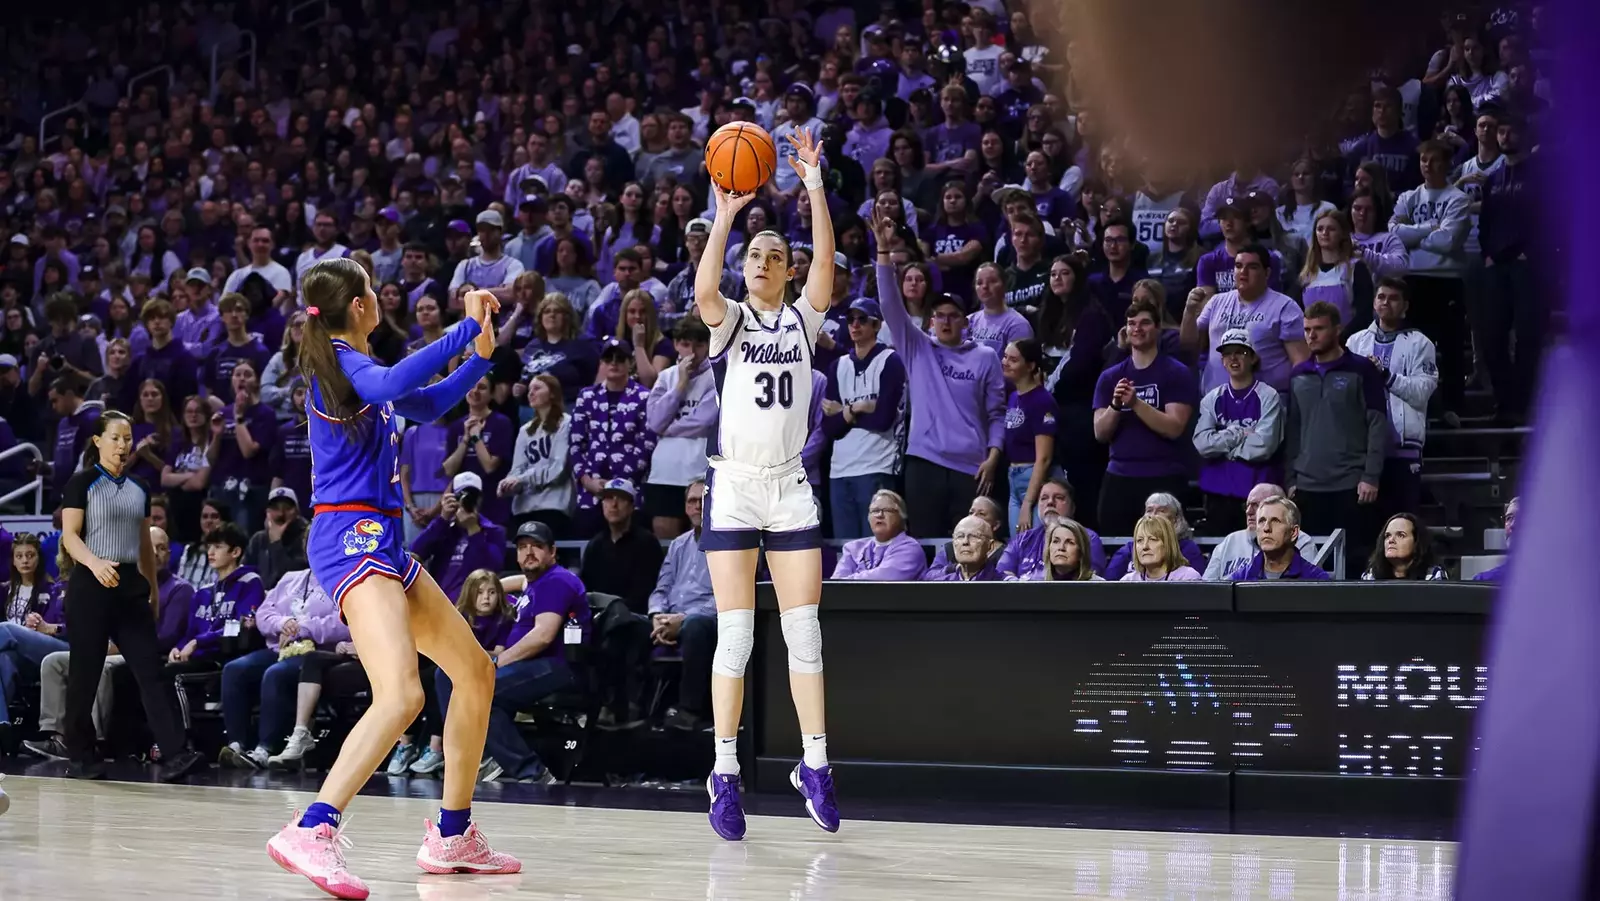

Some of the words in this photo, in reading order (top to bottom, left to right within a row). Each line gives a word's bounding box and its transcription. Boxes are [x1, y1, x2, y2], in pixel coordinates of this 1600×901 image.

[1139, 222, 1164, 242] 50
[1004, 282, 1046, 306] ILDCATS
[741, 341, 803, 365] Wildcats
[755, 370, 794, 410] 30
[319, 729, 331, 738] 27
[564, 740, 577, 750] 30
